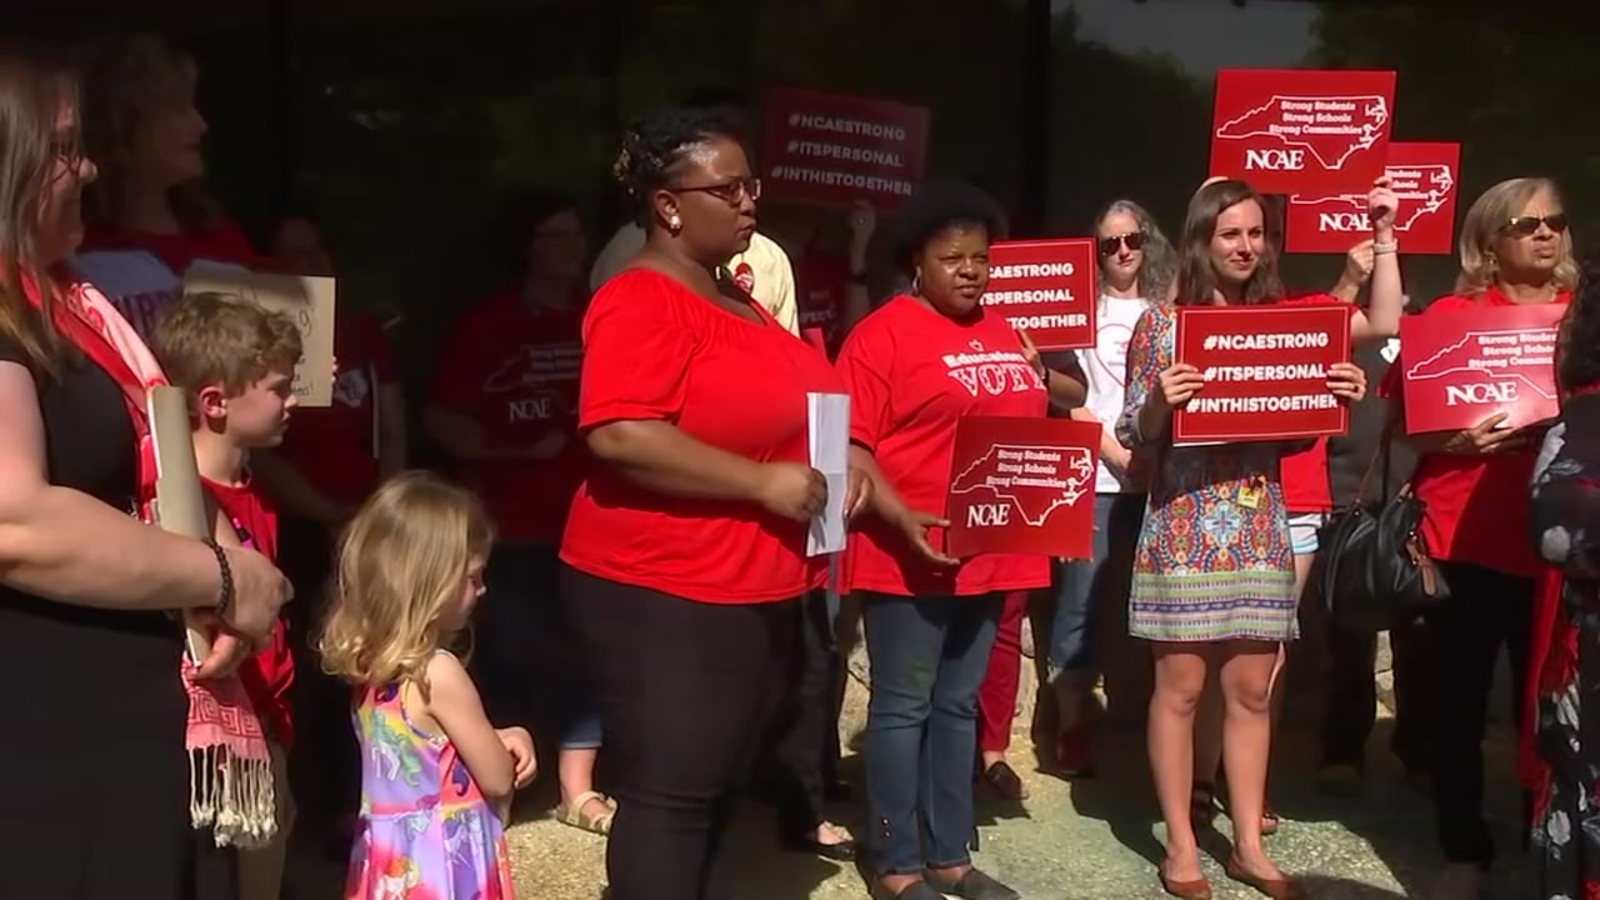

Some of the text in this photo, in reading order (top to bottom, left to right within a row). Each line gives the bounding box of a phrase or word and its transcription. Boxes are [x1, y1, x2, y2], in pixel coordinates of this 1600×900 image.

[1281, 101, 1355, 112] Strong Students
[1282, 113, 1352, 124] Strong Schools
[788, 113, 906, 141] #NCAESTRONG
[1269, 124, 1362, 136] Strong Communities
[787, 139, 904, 167] #ITSPERSONAL
[1245, 150, 1304, 169] NCAE
[770, 165, 912, 196] #INTHISTOGETHER
[1392, 180, 1418, 189] hools
[989, 263, 1074, 279] CAESTRONG
[1005, 314, 1087, 330] TOGETHER
[1203, 332, 1329, 350] #NCAESTRONG
[1478, 335, 1518, 345] Strong
[1482, 346, 1522, 356] Strong
[1468, 358, 1508, 368] Strong
[1203, 364, 1327, 382] #ITSPERSONAL
[1446, 382, 1519, 406] NCAE
[1186, 394, 1338, 413] #INTHISTOGETHER
[998, 449, 1061, 462] Strong Students
[998, 462, 1056, 475] Strong Schools
[986, 475, 1066, 488] Strong Communities
[967, 504, 1010, 528] NCAE
